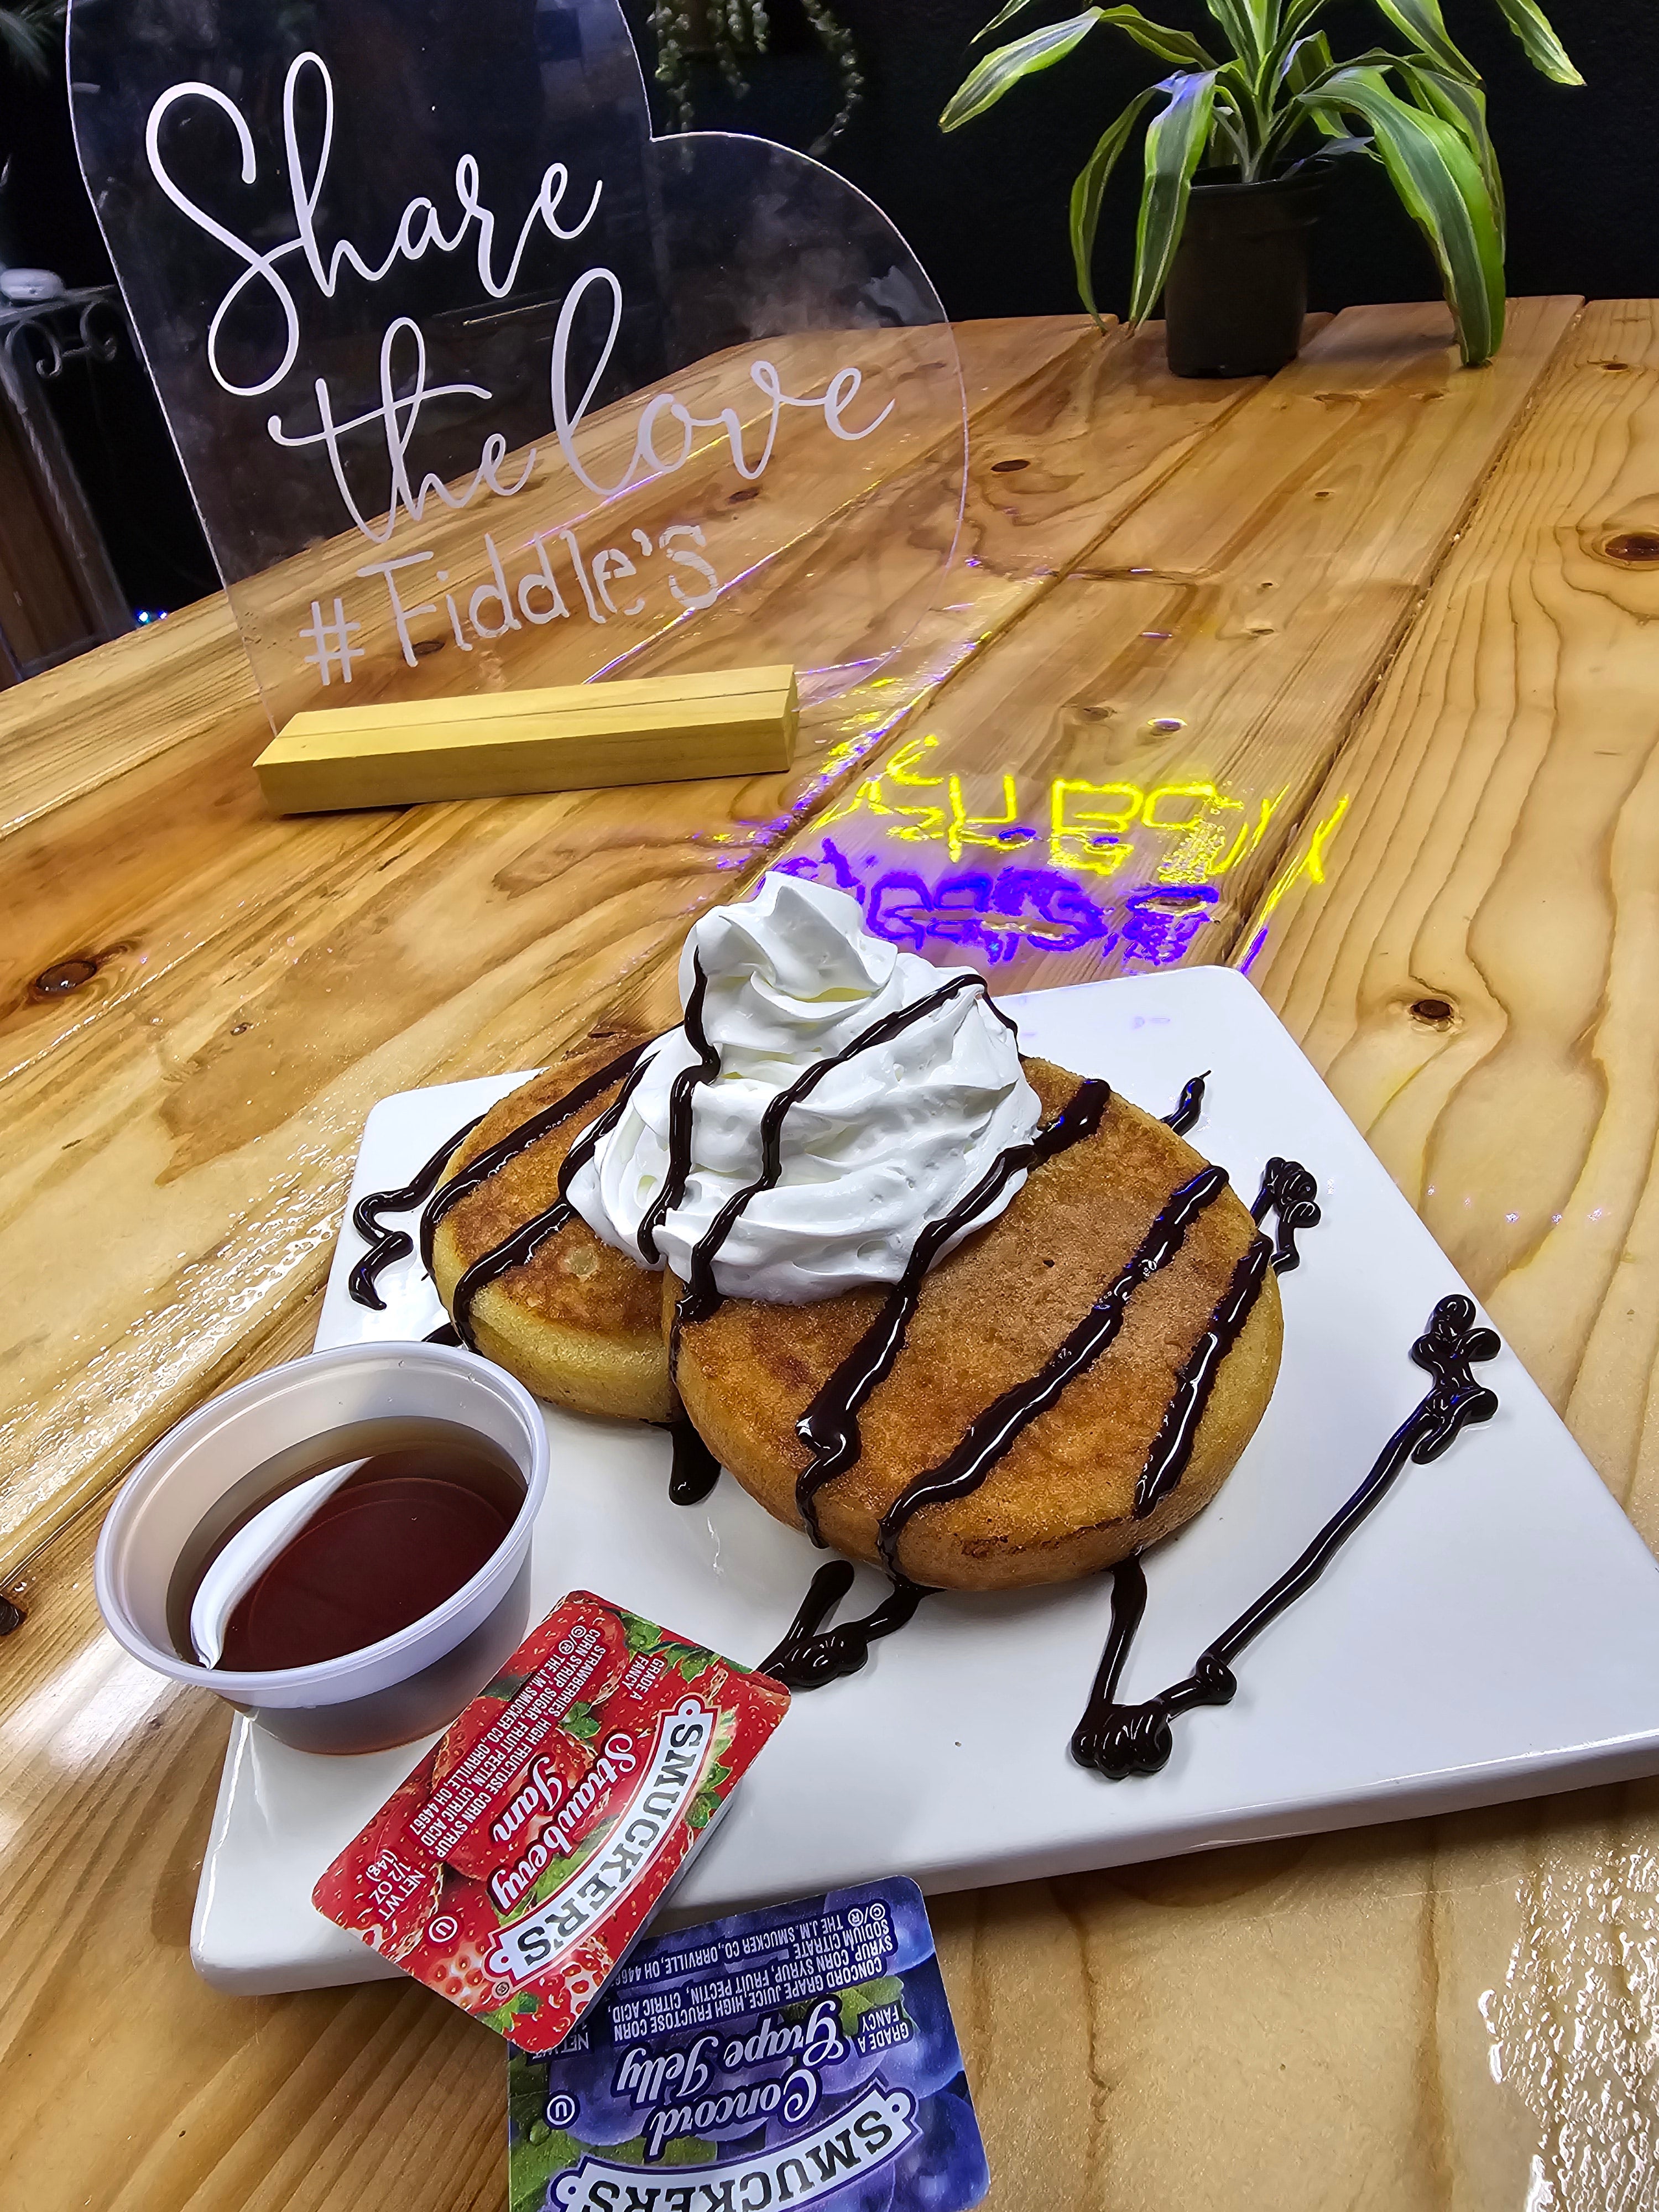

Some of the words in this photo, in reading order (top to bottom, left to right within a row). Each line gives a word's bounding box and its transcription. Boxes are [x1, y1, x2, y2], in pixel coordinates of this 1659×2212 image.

[147, 51, 603, 396] Share
[268, 317, 537, 546] the
[551, 268, 895, 497] love
[574, 1628, 601, 1657] CORN
[543, 1653, 566, 1673] THE
[621, 1655, 649, 1690] FANCY
[635, 1657, 665, 1693] GRADE
[496, 1686, 538, 1730] SMUCKER
[629, 1690, 643, 1700] A
[499, 1720, 529, 1754] FRUIT
[524, 1717, 552, 1745] HIGH
[484, 1741, 533, 1795] FRUCTOSE
[432, 1787, 453, 1806] OH
[441, 1786, 475, 1822] CITRIC
[461, 1791, 492, 1823] CORN
[493, 1755, 562, 1843] Jam
[409, 1802, 440, 1835] 44667
[420, 1817, 447, 1846] ACID
[491, 1732, 638, 1910] Strawberry
[518, 1721, 703, 1966] SMUCKER'S
[365, 1848, 398, 1882] (14g)
[387, 1858, 411, 1882] 1/2
[368, 1880, 393, 1905] OZ
[398, 1869, 426, 1897] NET
[378, 1893, 405, 1921] WT
[820, 1914, 844, 1934] THE
[842, 1918, 889, 1947] SODIUM
[742, 1926, 795, 1954] SMUCKER
[792, 1932, 841, 1960] CITRATE
[644, 1960, 660, 1979] OH
[815, 1948, 849, 1973] CORN
[826, 1955, 882, 1988] CONCORD
[606, 1965, 641, 1987] 4466
[735, 1969, 770, 1994] FRUIT
[783, 1974, 824, 2000] GRAPE
[642, 1991, 681, 2016] CITRIC
[649, 2002, 712, 2033] FRUCTOSE
[714, 1994, 744, 2017] HIGH
[613, 2018, 648, 2042] CORN
[723, 1999, 843, 2067] Grape
[862, 2004, 899, 2033] FANCY
[857, 2035, 866, 2053] A
[868, 2021, 909, 2050] GRADE
[617, 2036, 718, 2104] Jelly
[650, 2069, 817, 2157] Concord
[581, 2110, 891, 2212] SMUCKERS
